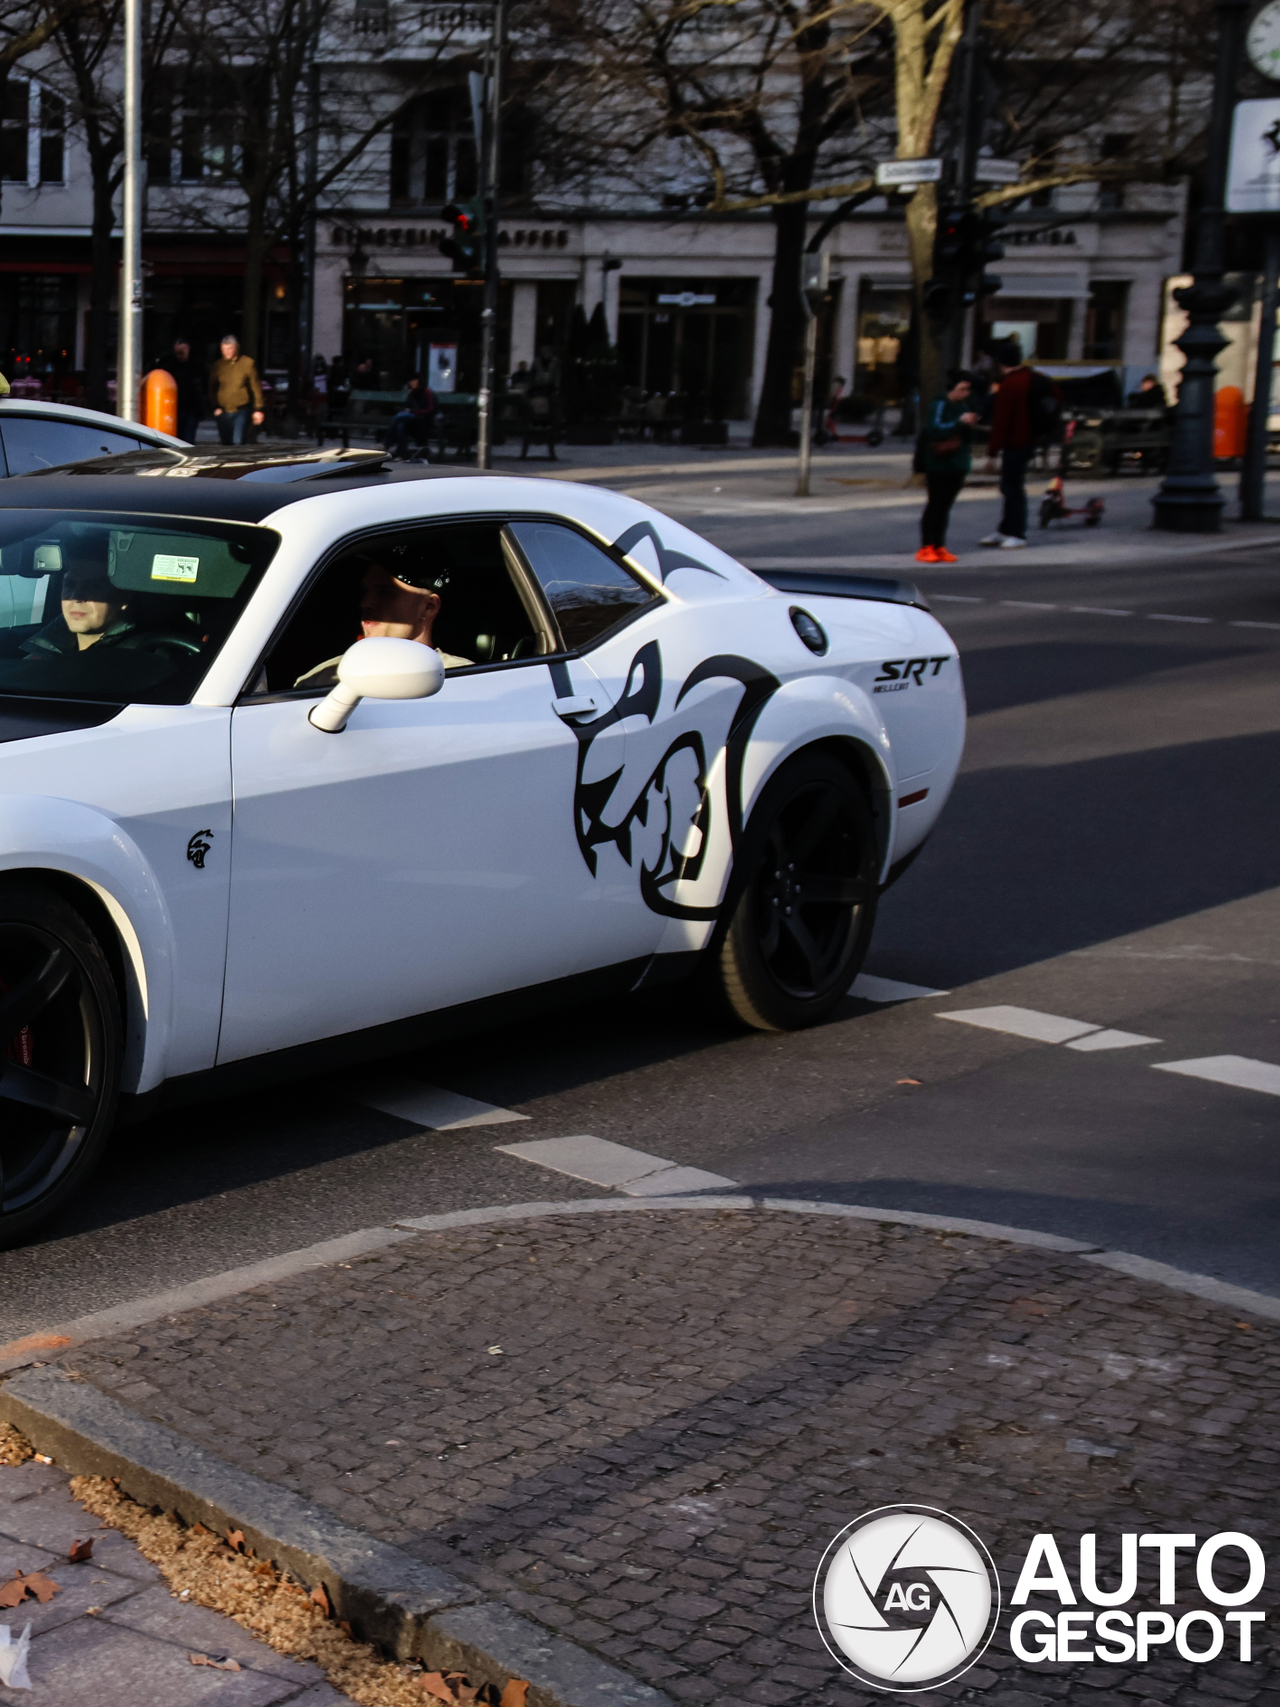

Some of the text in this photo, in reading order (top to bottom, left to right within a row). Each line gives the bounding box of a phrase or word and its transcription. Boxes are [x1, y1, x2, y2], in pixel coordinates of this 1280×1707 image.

[497, 229, 568, 247] AFFEE
[874, 656, 950, 686] SRT
[874, 682, 910, 693] HELLCAT
[21, 1034, 29, 1065] bremb
